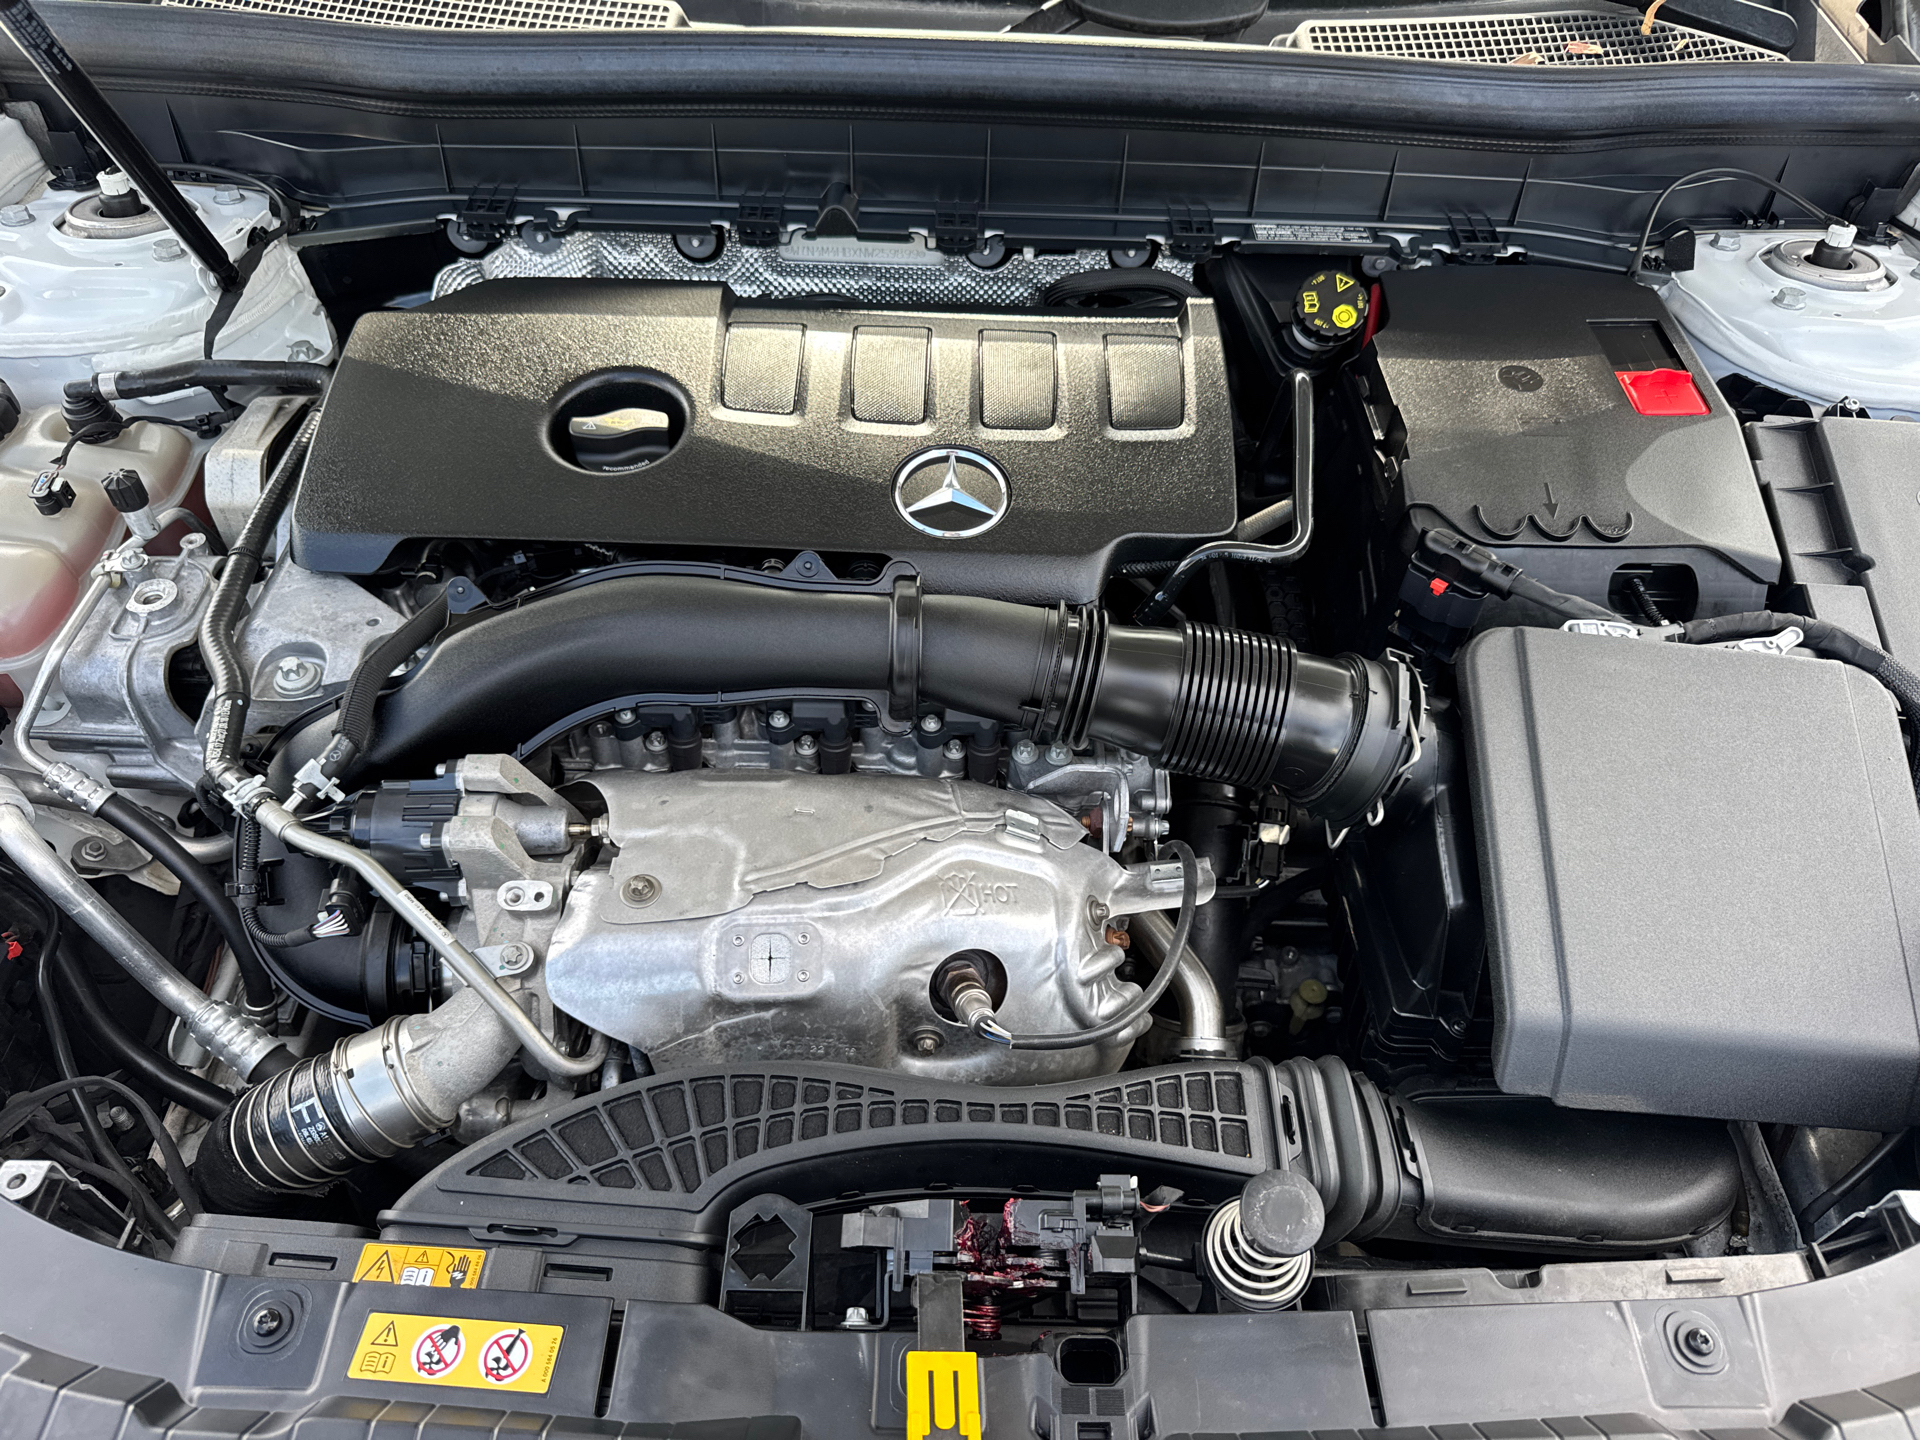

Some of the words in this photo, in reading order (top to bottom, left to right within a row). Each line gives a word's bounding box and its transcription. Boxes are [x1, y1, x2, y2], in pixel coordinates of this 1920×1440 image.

[602, 459, 650, 471] recommended
[979, 882, 1019, 904] HOT
[545, 1354, 553, 1365] 584
[542, 1366, 550, 1377] 000
